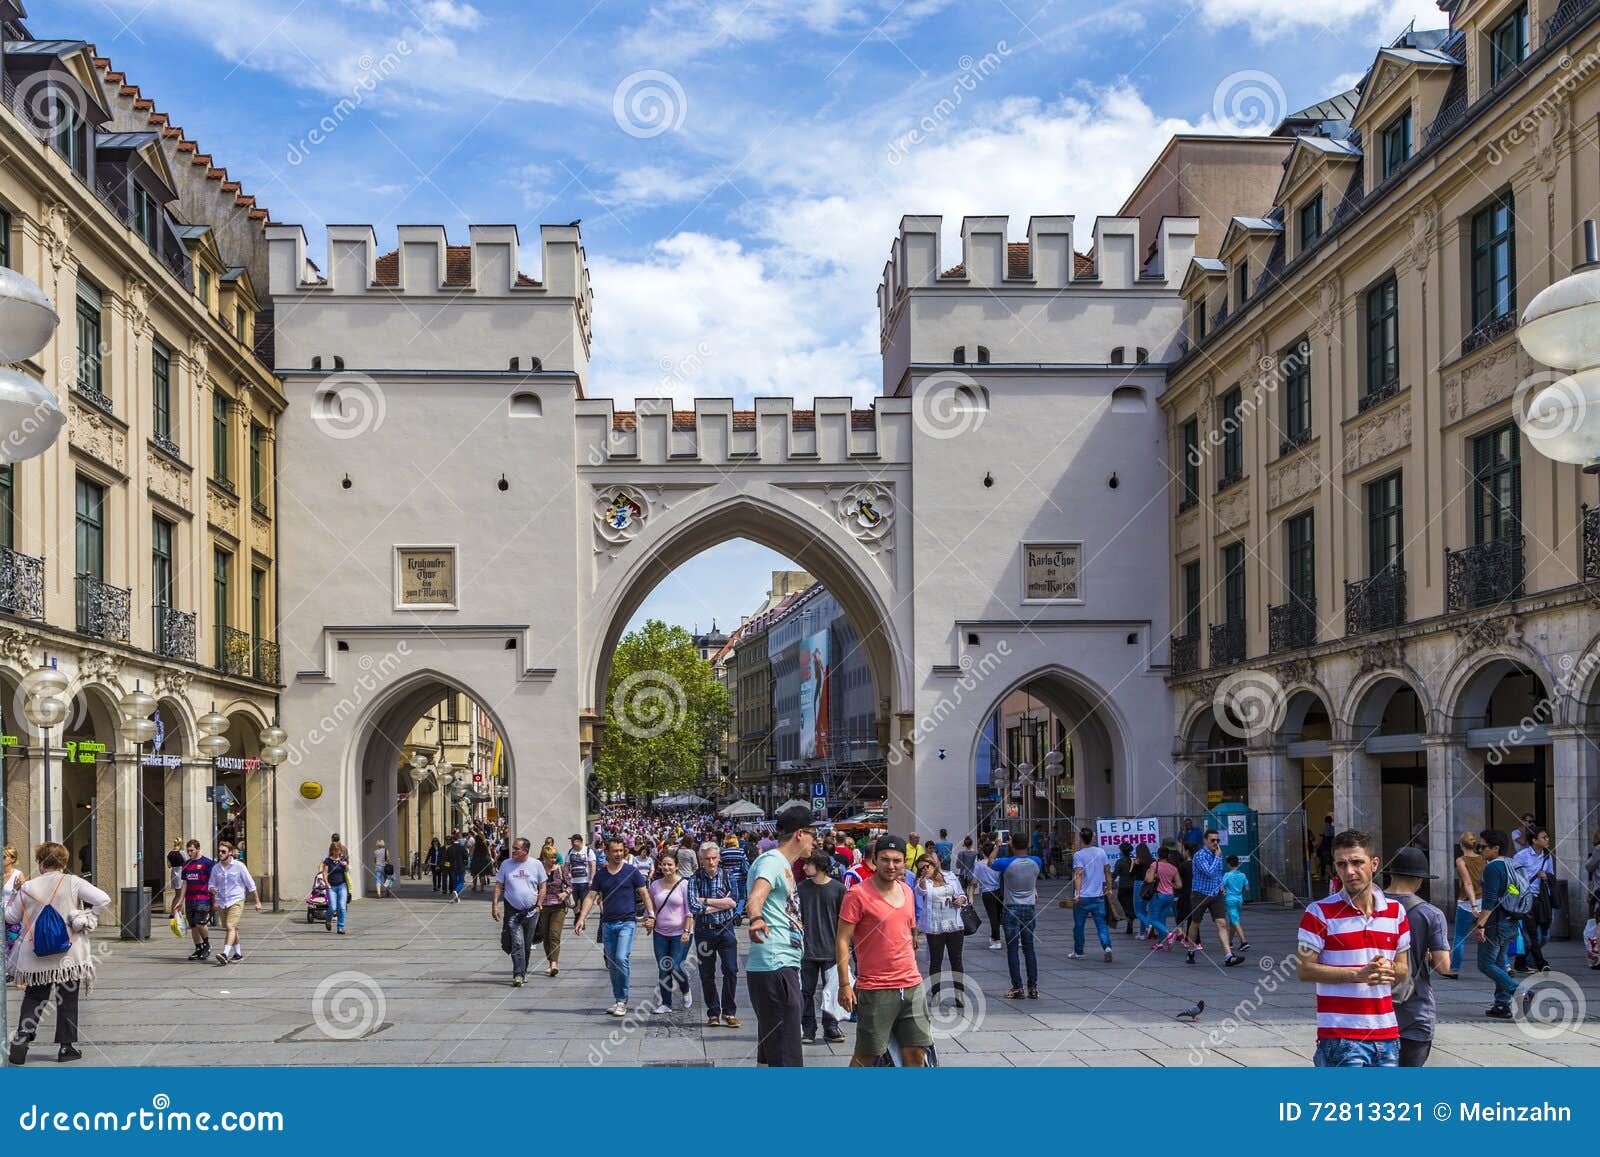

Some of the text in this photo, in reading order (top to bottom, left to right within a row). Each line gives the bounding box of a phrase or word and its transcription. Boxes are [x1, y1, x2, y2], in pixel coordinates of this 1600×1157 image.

[815, 784, 823, 796] U
[1100, 820, 1156, 833] LEDER
[1100, 833, 1156, 846] FISCHER
